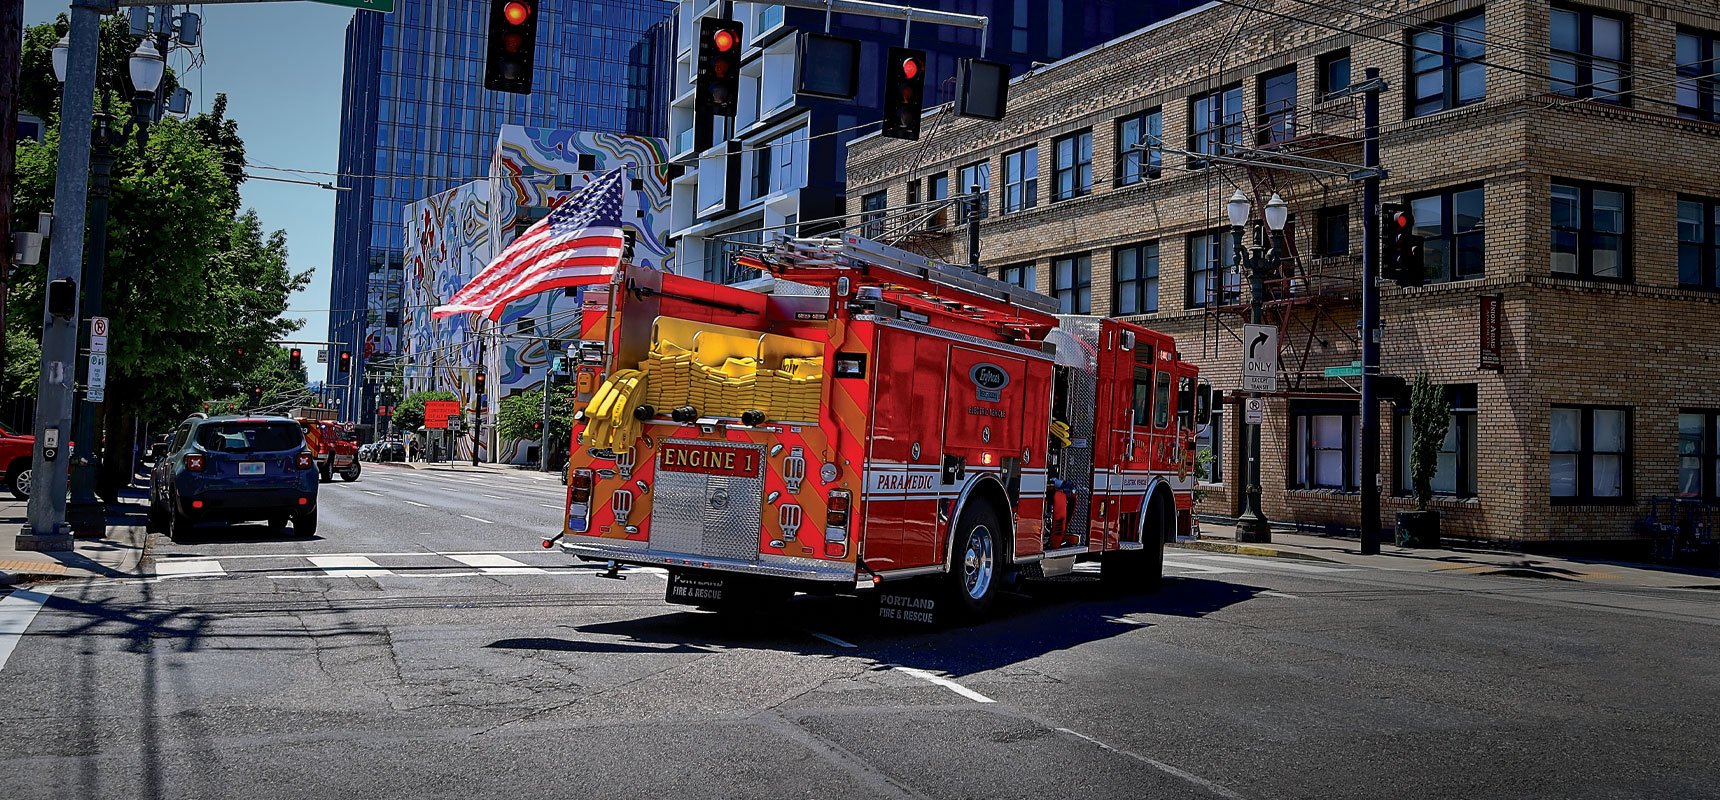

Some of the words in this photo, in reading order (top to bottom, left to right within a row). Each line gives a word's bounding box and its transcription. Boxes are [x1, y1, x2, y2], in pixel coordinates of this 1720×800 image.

[1248, 361, 1272, 372] ONLY
[664, 448, 736, 470] ENGINE
[744, 454, 753, 471] 1
[877, 474, 934, 490] PARAMEDIC
[673, 586, 688, 596] FIRE
[688, 587, 694, 597] &
[694, 588, 722, 600] RESCUE
[880, 594, 935, 610] PORTLAND
[879, 607, 896, 619] FIRE
[896, 609, 902, 620] &
[903, 610, 933, 623] RESCUE
